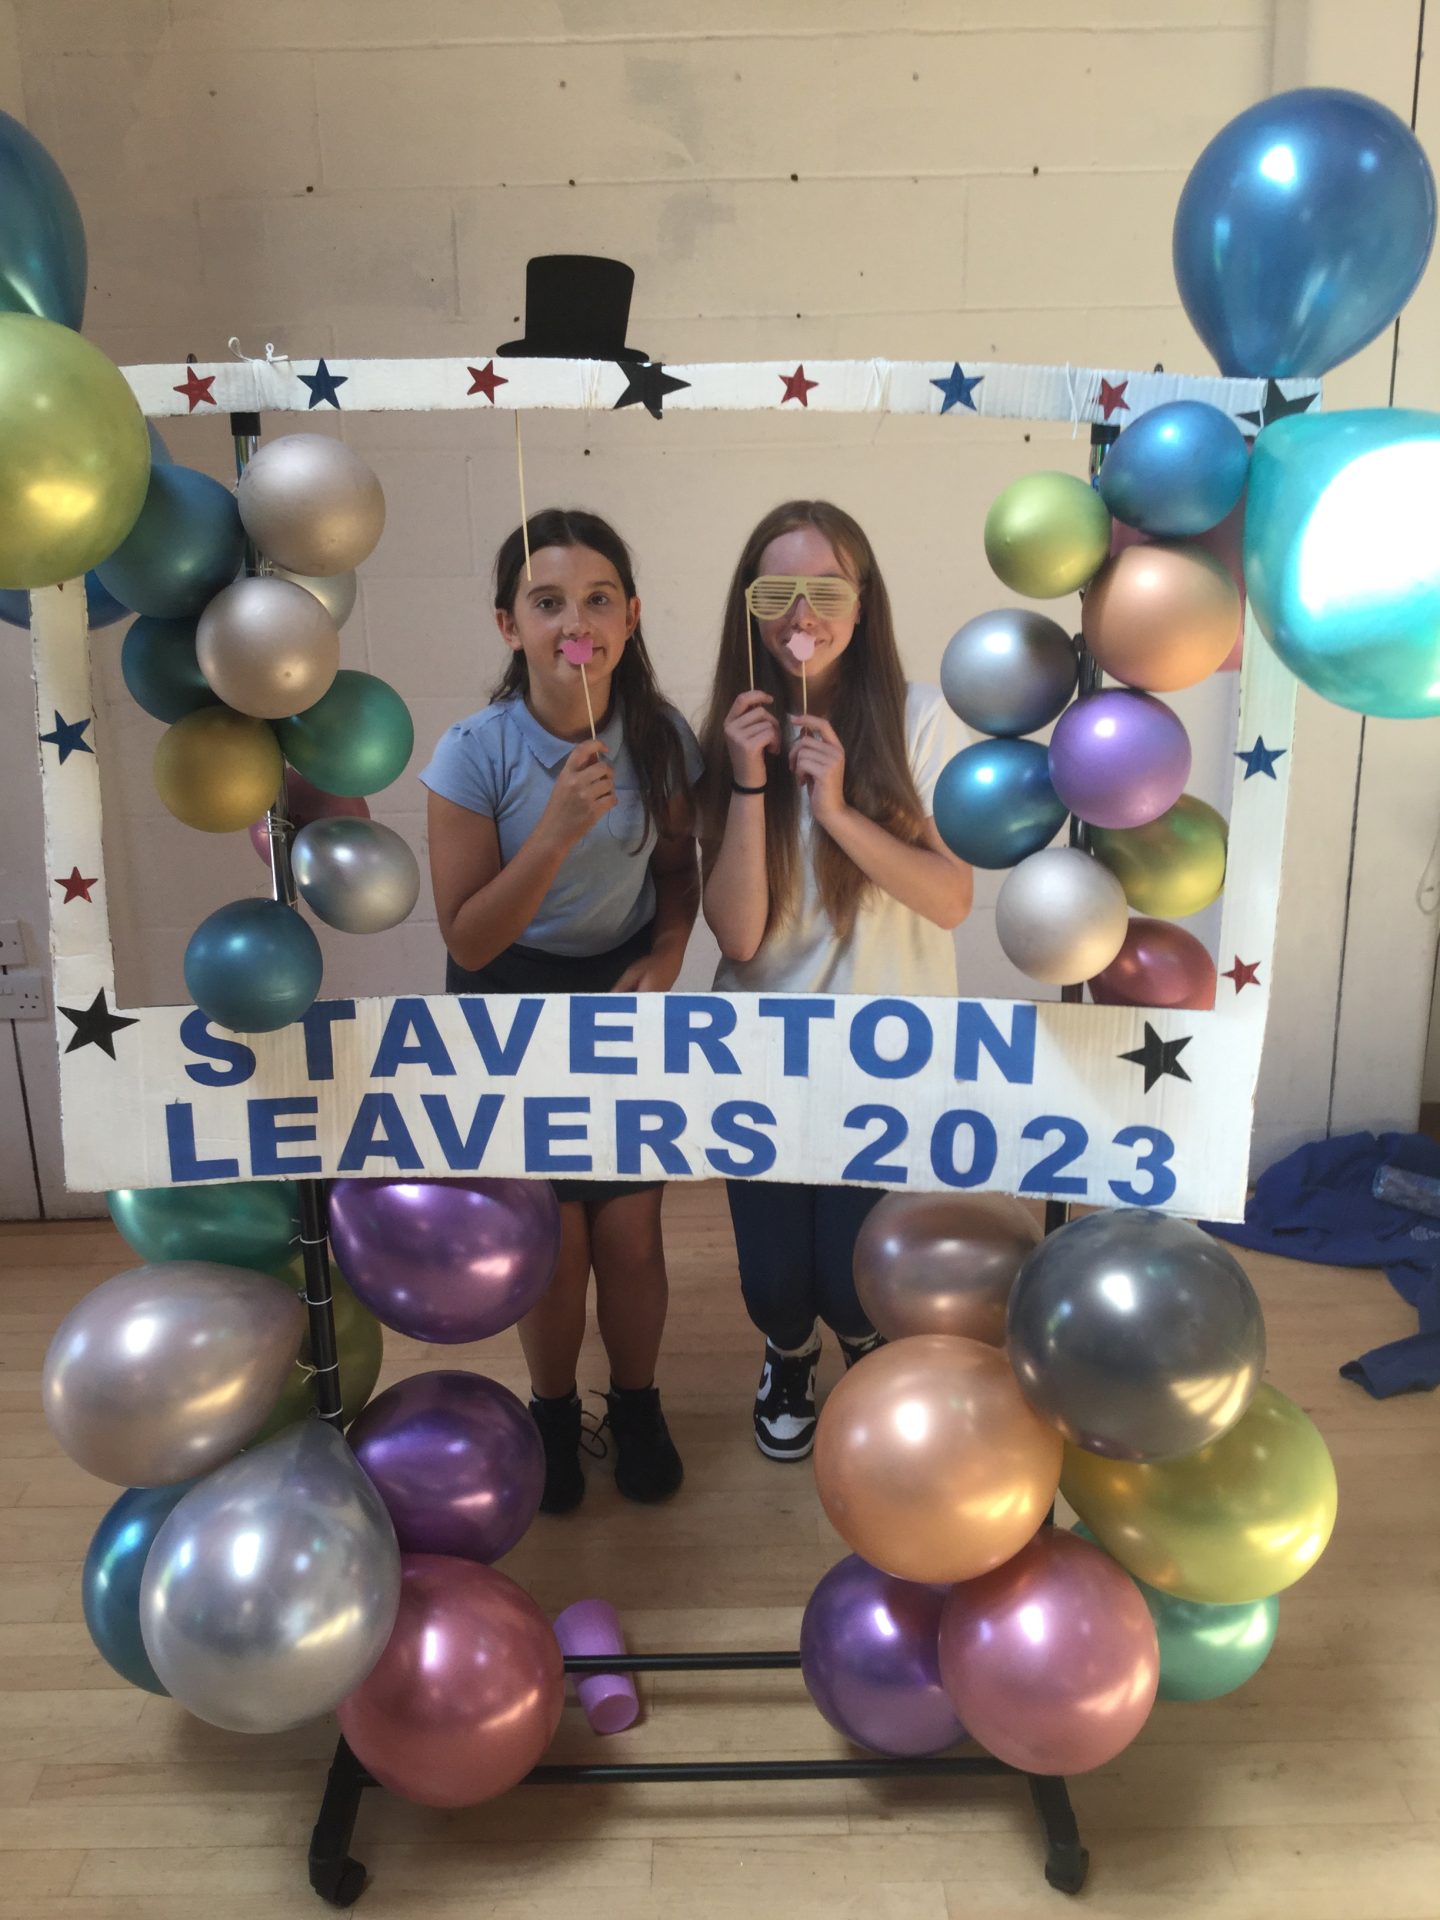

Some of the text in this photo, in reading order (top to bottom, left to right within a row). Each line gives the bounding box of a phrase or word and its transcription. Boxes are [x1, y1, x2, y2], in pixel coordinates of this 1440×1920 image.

[180, 995, 1037, 1087] STAVERTON
[166, 1093, 1177, 1206] LEAVERS 2023
